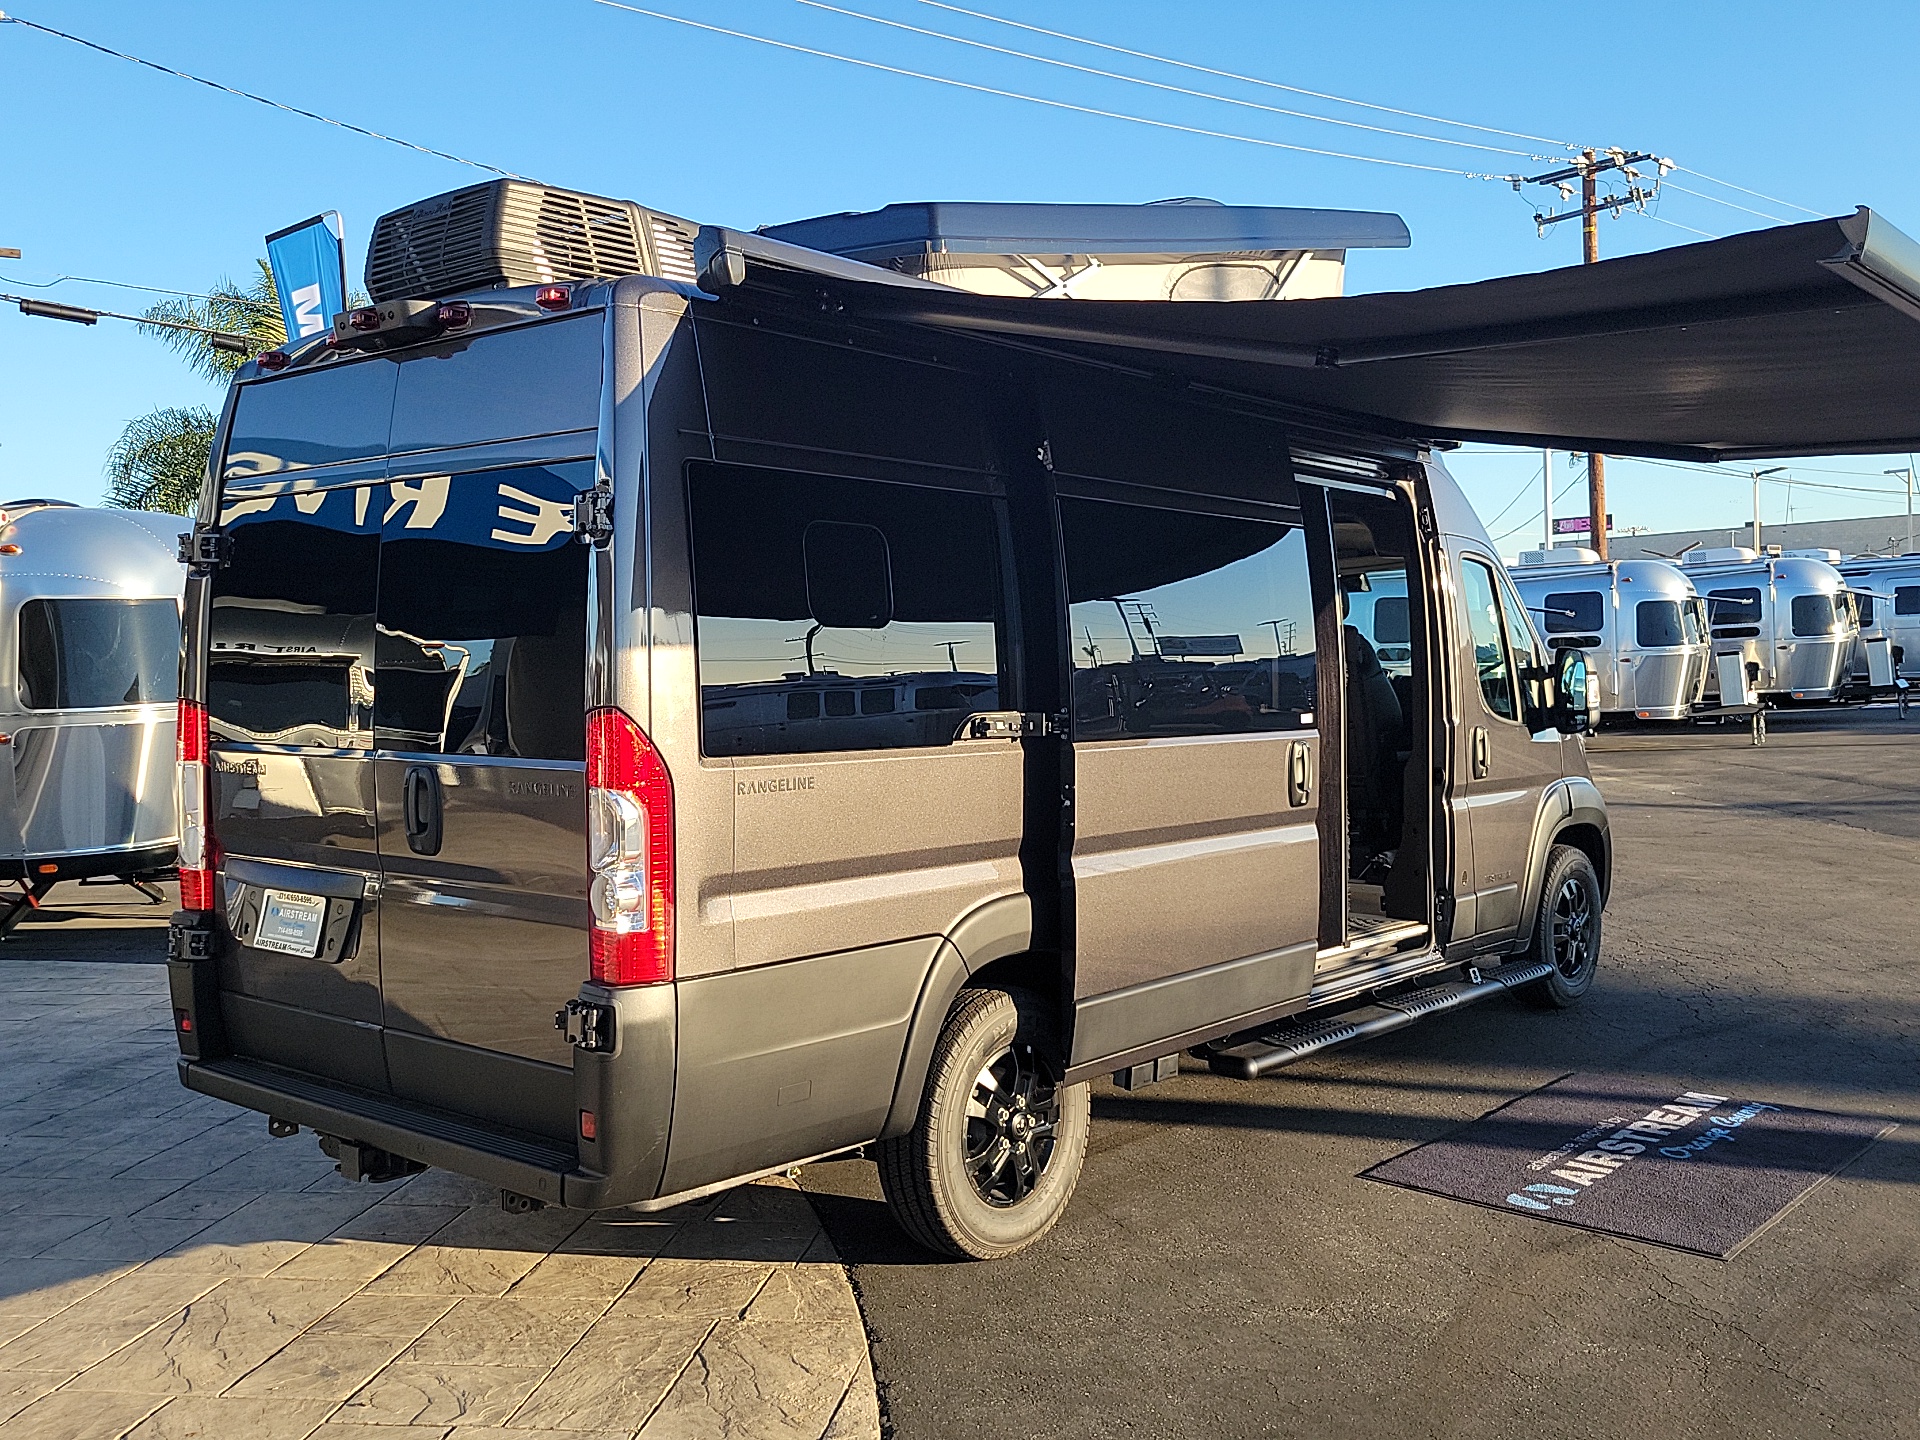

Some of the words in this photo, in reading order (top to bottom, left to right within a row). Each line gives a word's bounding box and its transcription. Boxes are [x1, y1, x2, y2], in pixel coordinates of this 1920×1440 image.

[214, 760, 267, 775] AIRSTREAM
[508, 781, 577, 799] RANGELINE
[737, 776, 815, 796] RANGELINE
[279, 909, 318, 922] AIRSTREAM
[254, 938, 288, 950] AIRSTREAM
[1551, 1091, 1729, 1187] AIRSTREAM
[1659, 1125, 1735, 1160] Orange
[1708, 1100, 1782, 1128] County
